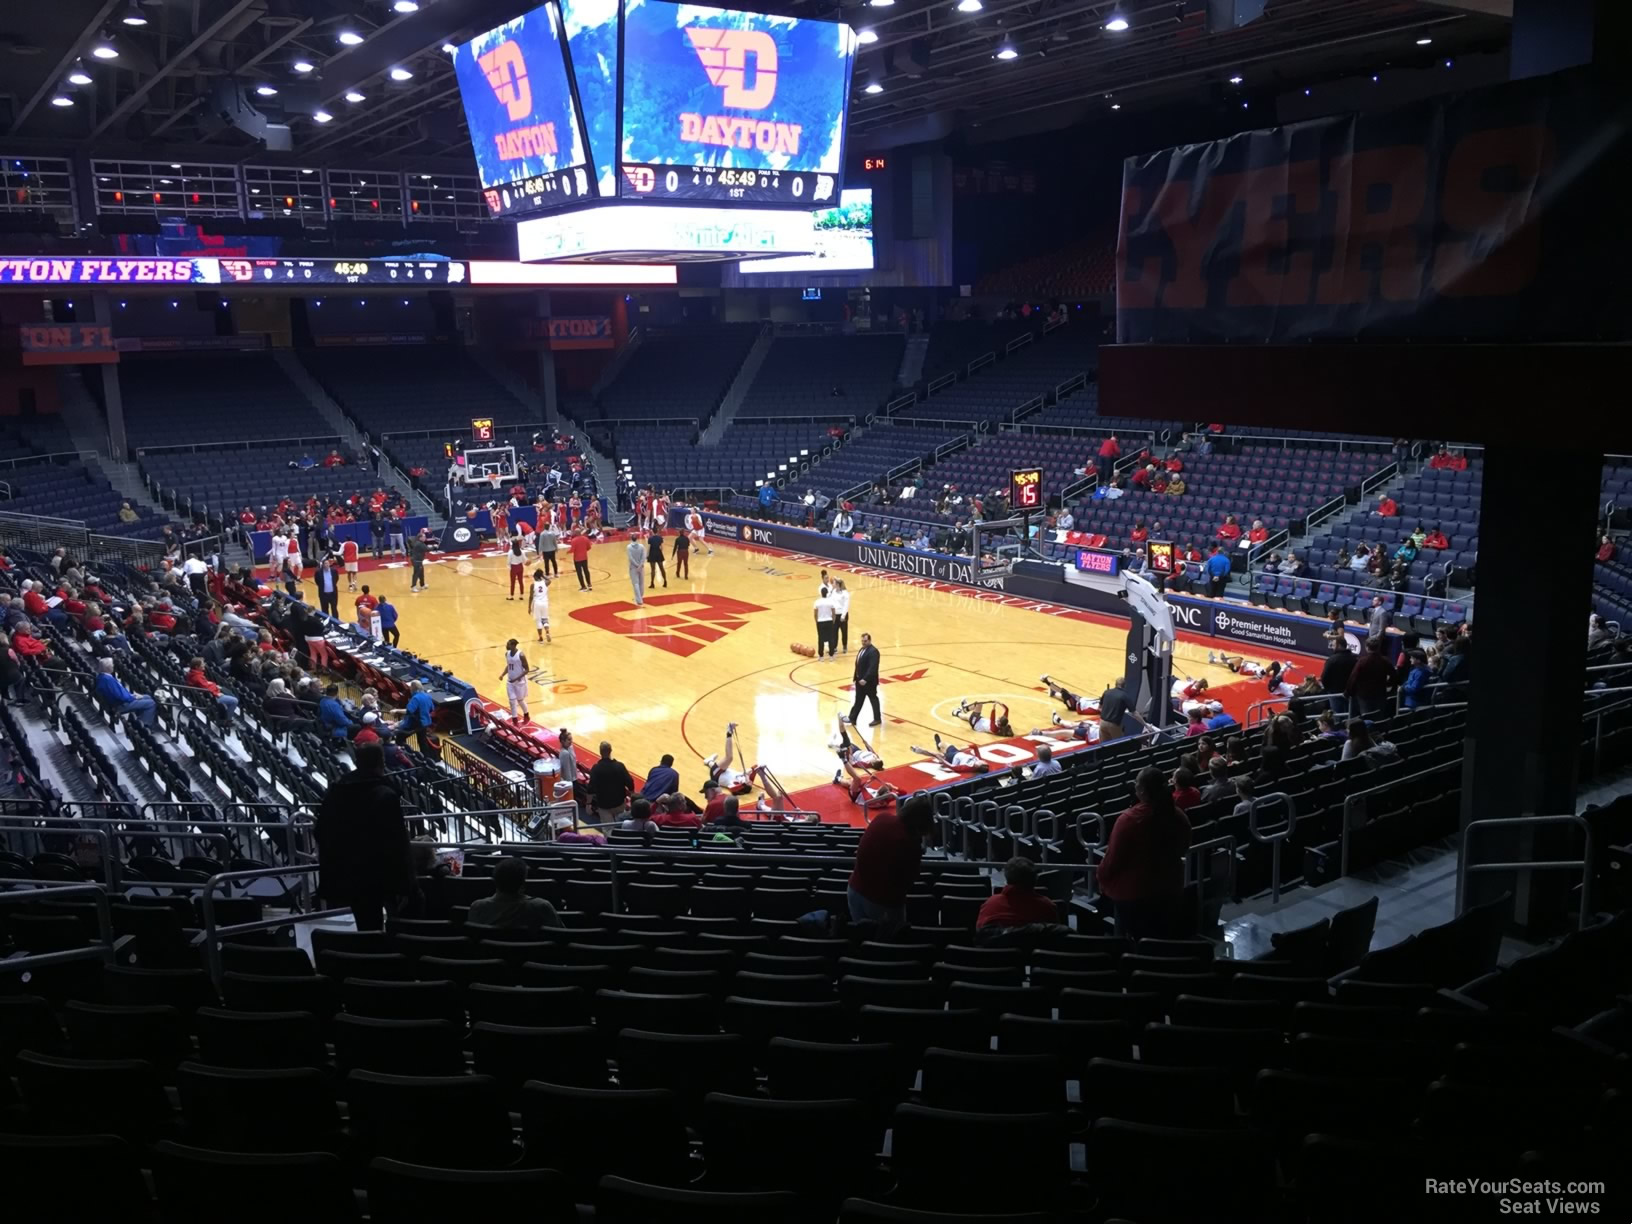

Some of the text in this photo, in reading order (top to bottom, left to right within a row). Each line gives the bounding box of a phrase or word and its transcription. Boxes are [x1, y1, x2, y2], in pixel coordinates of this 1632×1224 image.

[495, 122, 558, 161] DAYTON
[679, 113, 802, 157] DAYTON
[665, 171, 678, 192] 0
[692, 175, 713, 186] 4 0
[718, 170, 756, 186] 45:49
[761, 178, 779, 188] 0 4
[729, 188, 745, 197] 1ST
[792, 177, 803, 197] 0
[80, 260, 192, 281] FLYERS
[264, 268, 312, 279] 0 4 0
[334, 263, 368, 275] 45:49
[390, 269, 433, 279] 0 4 0
[480, 427, 490, 438] 15
[1015, 472, 1038, 485] 45:49
[1023, 484, 1035, 504] 15
[754, 528, 772, 544] PNC
[858, 545, 937, 577] UNIVERSITY
[939, 565, 946, 576] of
[1080, 552, 1113, 565] DAYTON
[1081, 559, 1111, 572] FLYERS
[1157, 555, 1168, 568] 15
[1231, 618, 1291, 637] Premier Health
[1231, 628, 1296, 646] Good Samaritan Hospital
